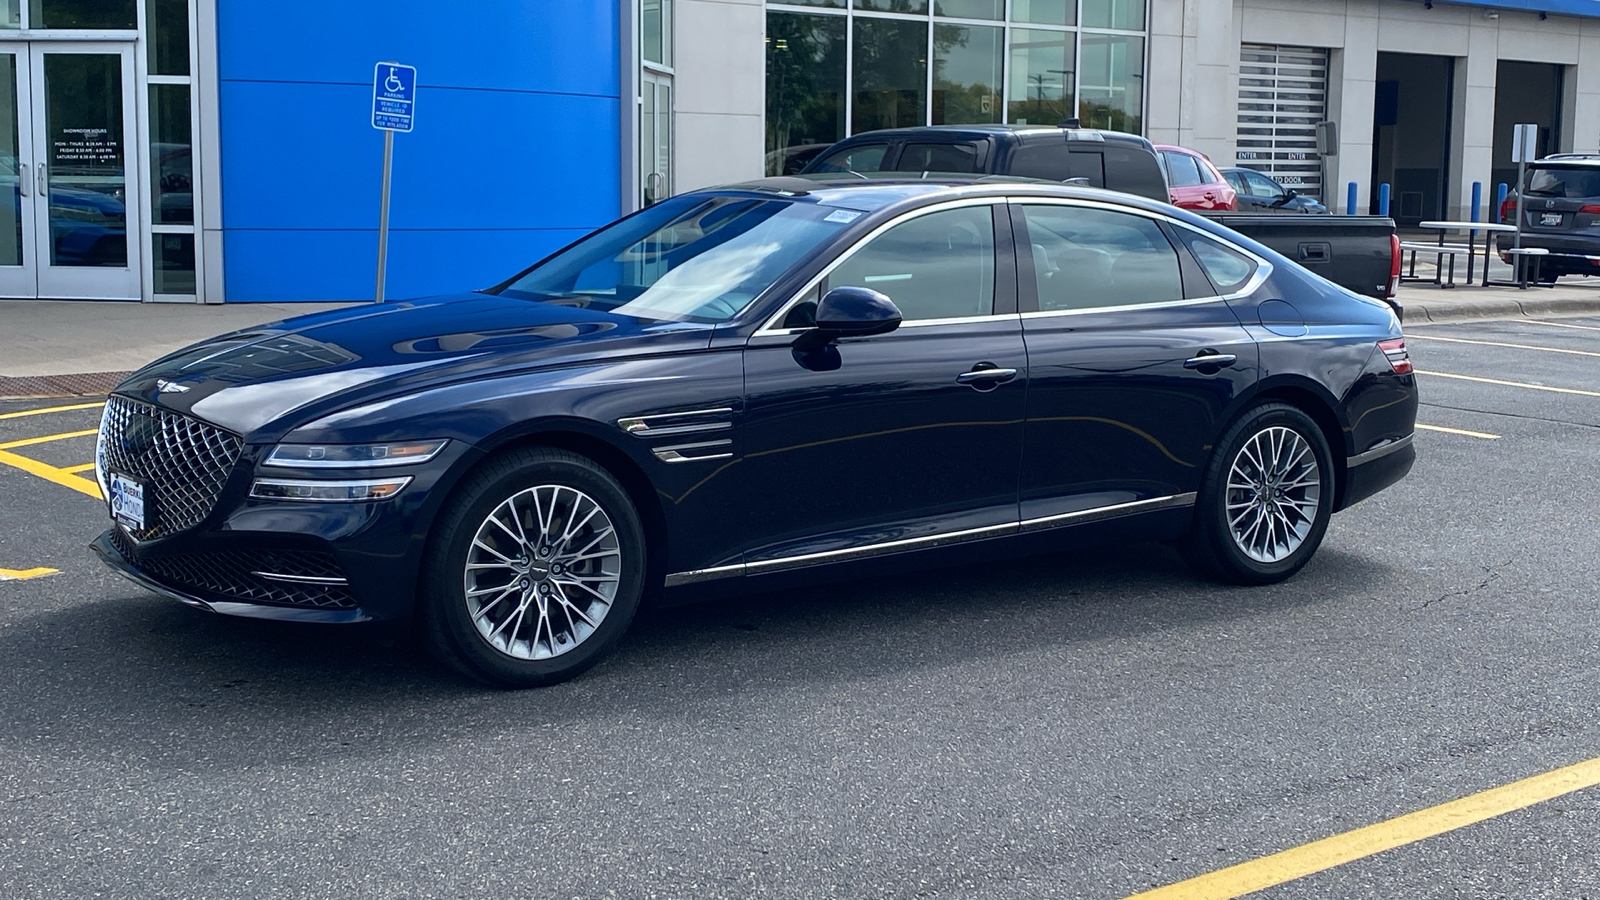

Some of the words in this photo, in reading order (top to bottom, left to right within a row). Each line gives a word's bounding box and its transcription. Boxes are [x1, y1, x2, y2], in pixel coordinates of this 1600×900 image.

[1238, 152, 1257, 160] ENTER
[1288, 152, 1306, 160] ENTER
[122, 482, 143, 500] BUERKL
